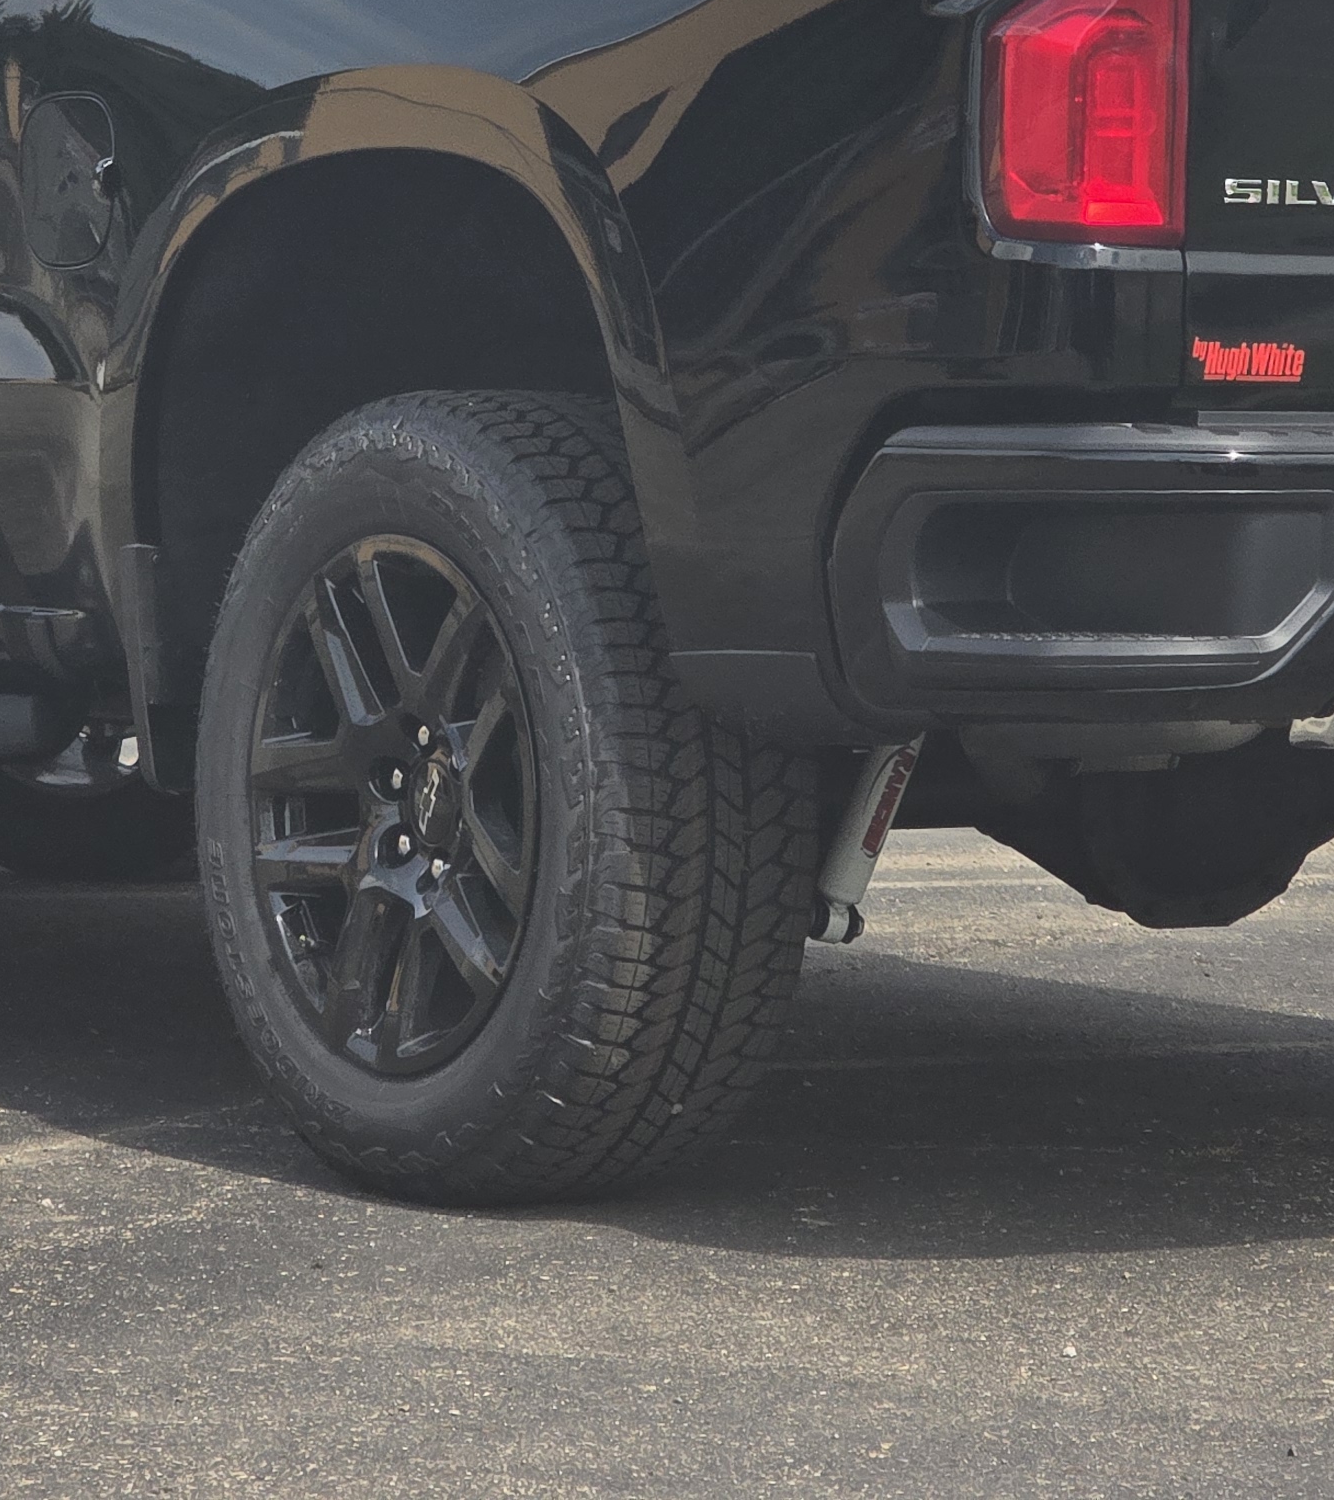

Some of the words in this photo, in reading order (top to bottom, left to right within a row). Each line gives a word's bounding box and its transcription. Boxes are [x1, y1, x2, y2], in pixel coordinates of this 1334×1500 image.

[1192, 336, 1208, 361] by
[1204, 341, 1250, 380] Hugh
[1251, 343, 1305, 376] White
